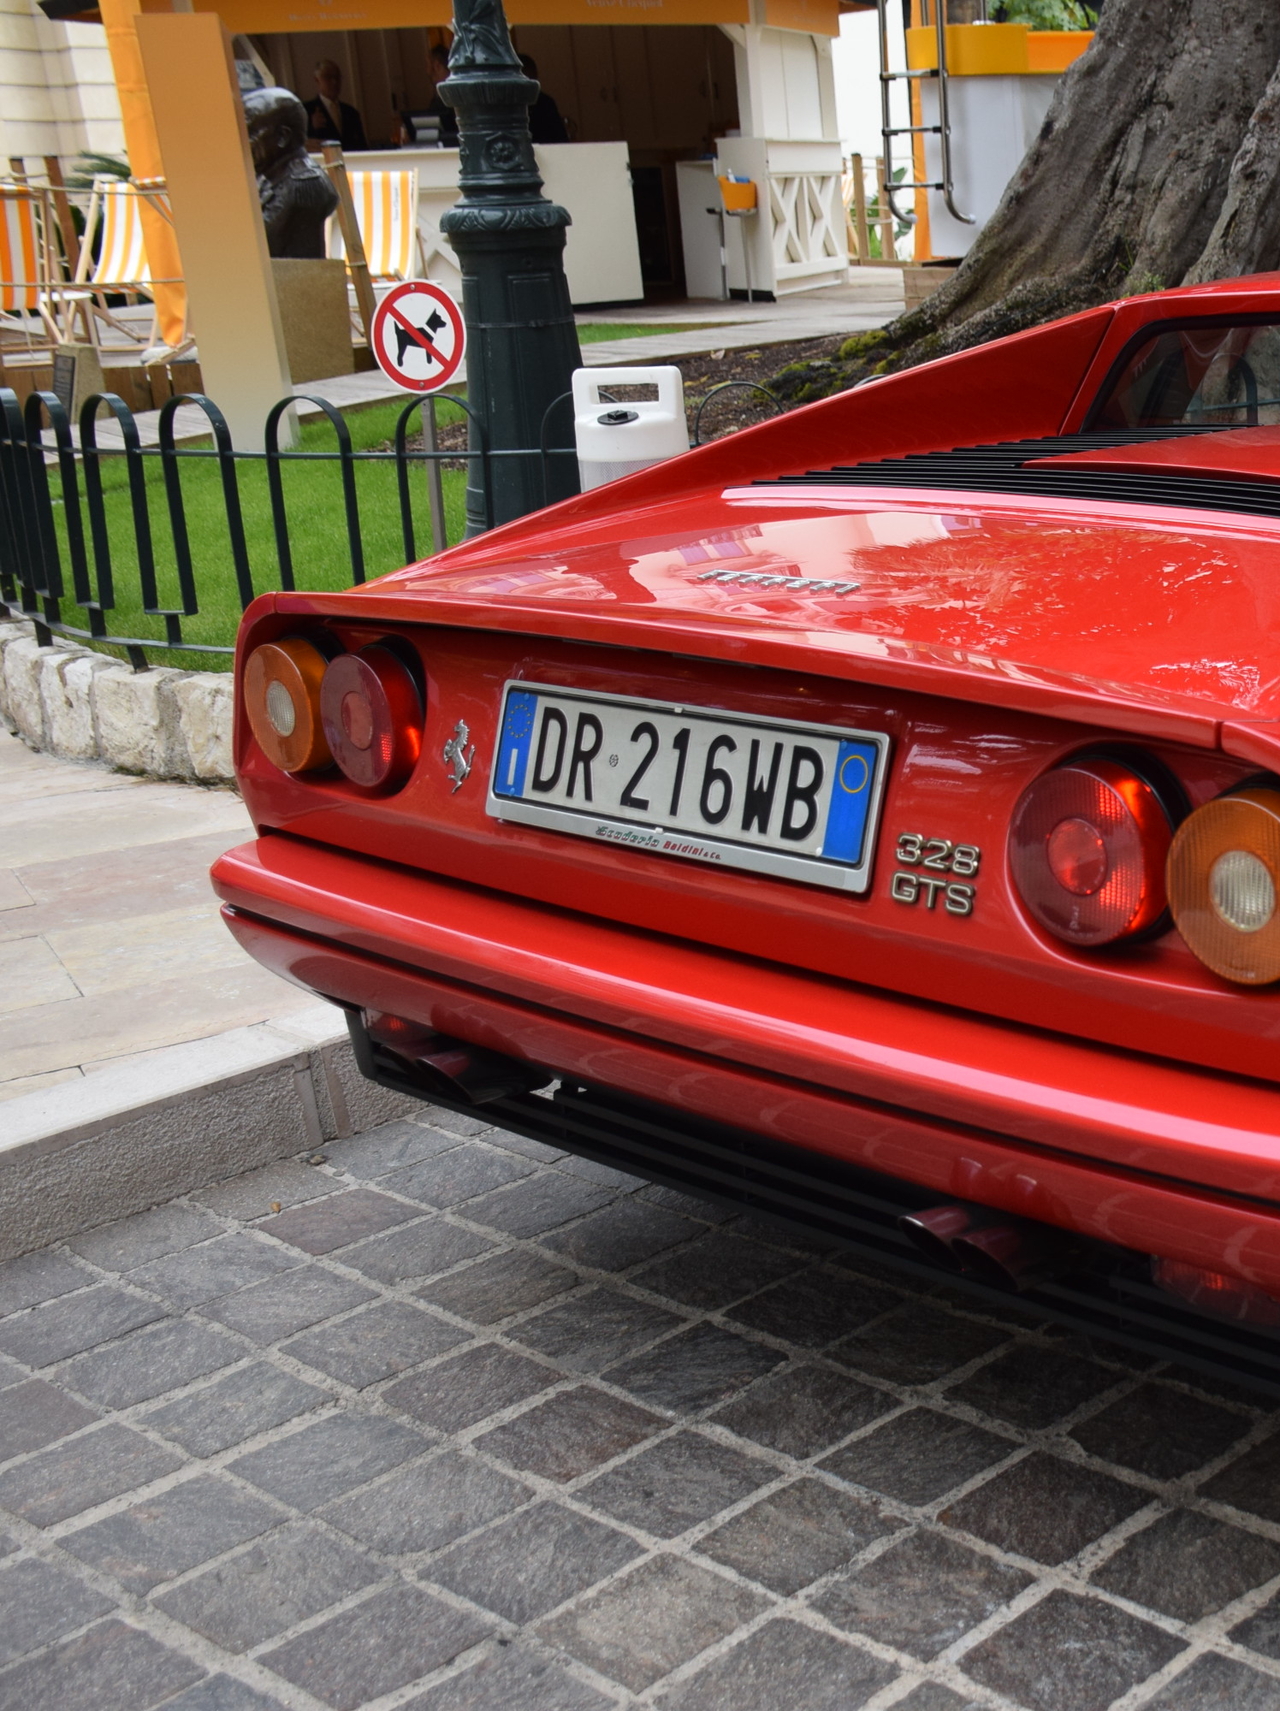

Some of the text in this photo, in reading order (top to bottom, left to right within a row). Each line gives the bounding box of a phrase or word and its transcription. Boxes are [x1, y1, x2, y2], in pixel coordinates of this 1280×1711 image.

[531, 706, 824, 841] DR 216WB
[663, 840, 704, 857] Baldini
[896, 832, 981, 877] 328
[892, 870, 976, 916] GTS
